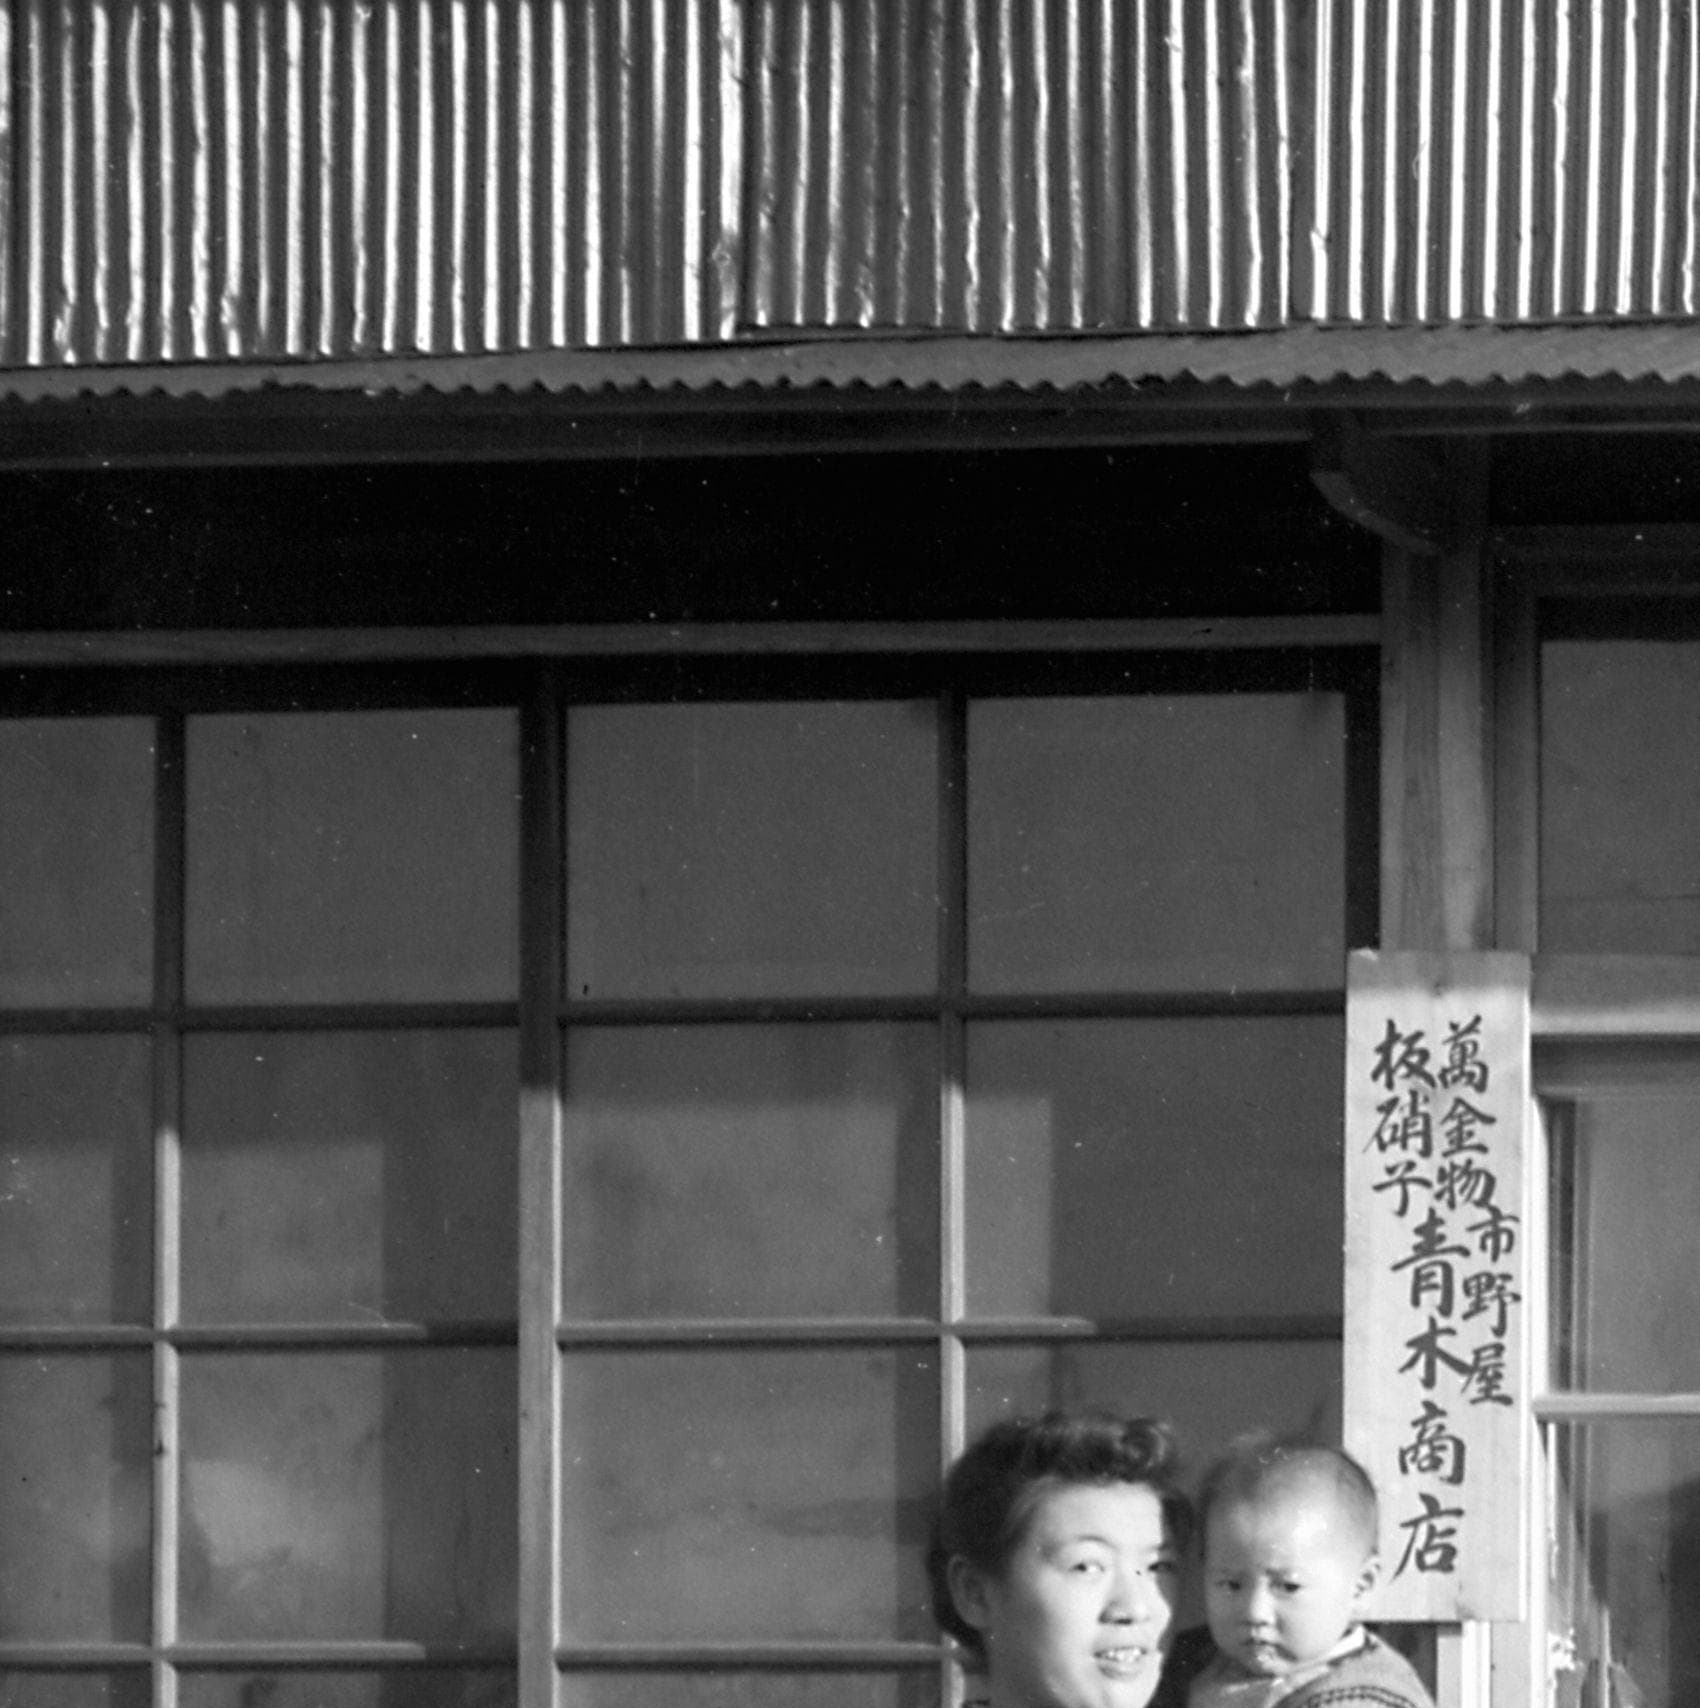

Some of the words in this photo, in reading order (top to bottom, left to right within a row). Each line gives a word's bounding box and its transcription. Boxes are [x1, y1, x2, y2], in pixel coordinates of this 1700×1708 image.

[1364, 1019, 1437, 1217] 板硝子
[1437, 1015, 1497, 1210] 萬金物
[1391, 1207, 1472, 1578] 青木商店
[1462, 1204, 1521, 1406] 市野屋
